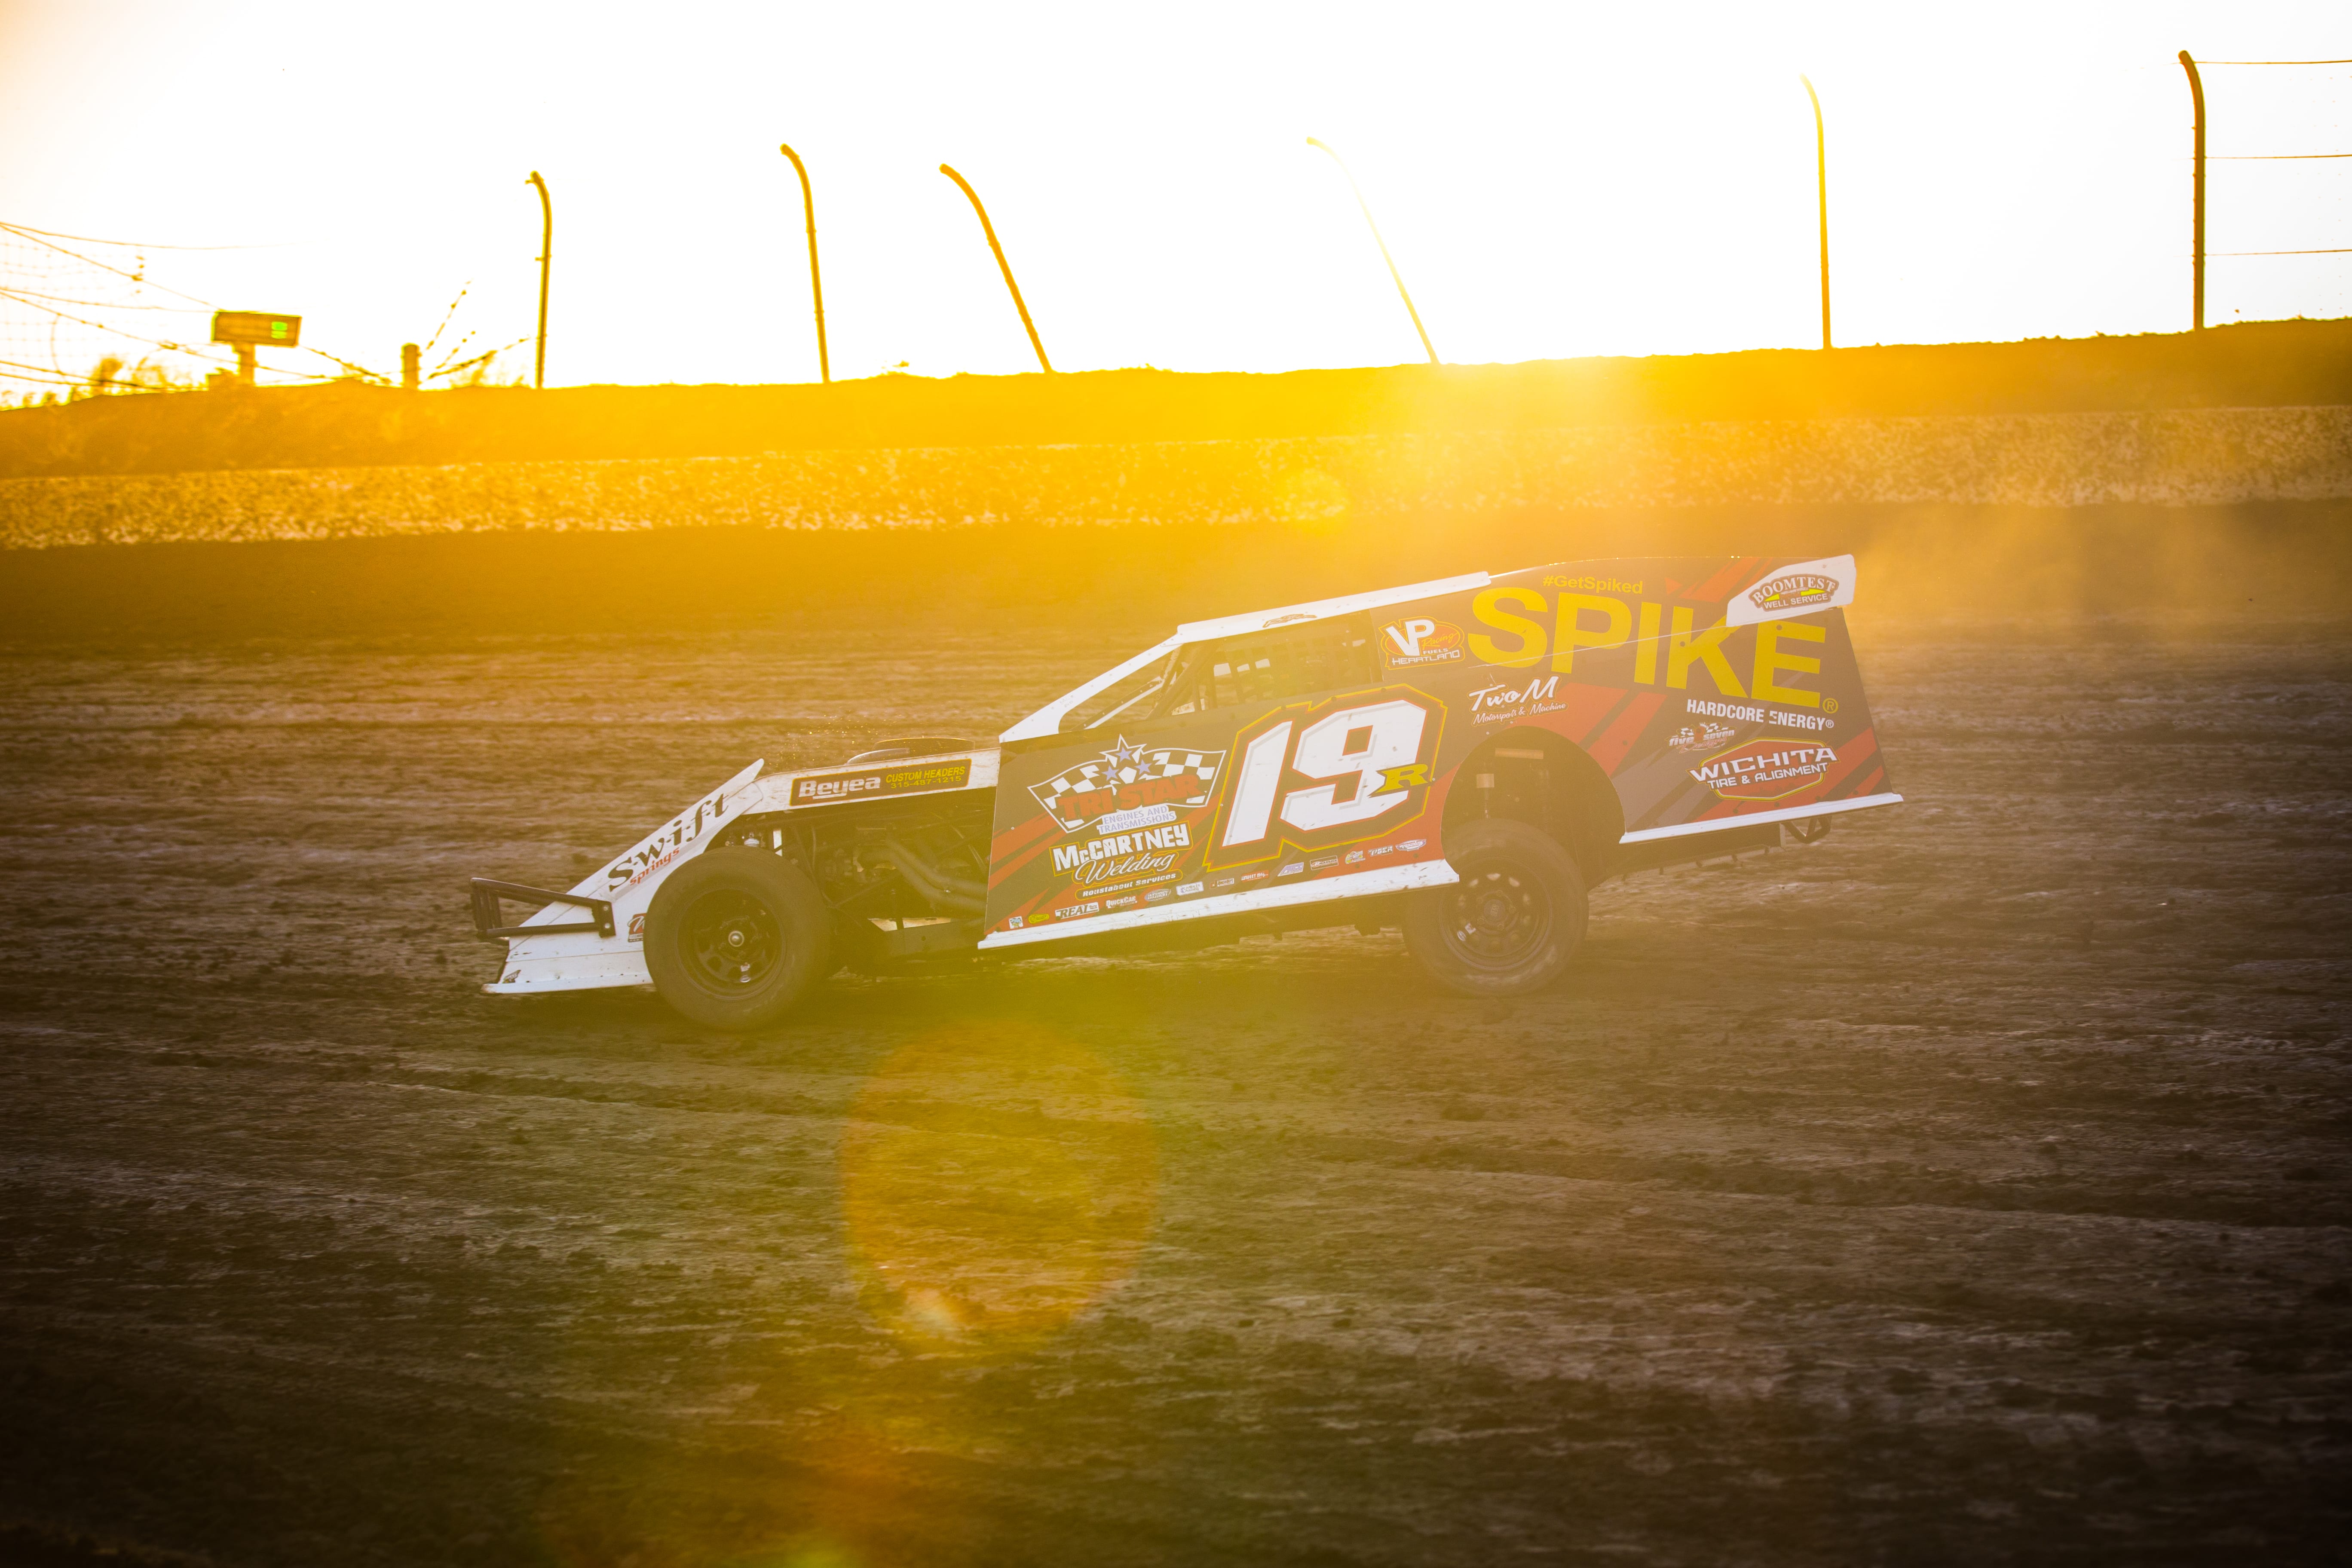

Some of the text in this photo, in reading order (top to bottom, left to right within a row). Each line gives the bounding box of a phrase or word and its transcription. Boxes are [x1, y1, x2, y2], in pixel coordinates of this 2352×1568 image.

[1543, 575, 1643, 594] #GetSpiked
[1752, 576, 1836, 604] BOOMTEST
[1764, 593, 1828, 609] WELL SERVICE
[1385, 619, 1435, 656] VP
[1421, 632, 1458, 650] Racing
[1392, 649, 1460, 665] HEARTLAND
[1468, 676, 1559, 710] Two M
[1519, 706, 1525, 715] &
[1529, 703, 1566, 715] Machine
[1686, 699, 1764, 723] HARDCORE
[1669, 729, 1735, 747] five seven
[885, 766, 966, 784] CUSTOM HEADERS
[1222, 700, 1427, 847] 19
[1689, 747, 1838, 782] WICHITA
[1707, 762, 1828, 789] TIRE & ALIGNMENT
[798, 777, 881, 799] Beyea
[891, 775, 962, 789] 315-487-1215
[1057, 774, 1204, 820] TRI STAR
[1098, 812, 1176, 833] TRANSMISSIONS
[1103, 805, 1168, 825] ENGINES AND
[608, 793, 729, 892] Swift
[630, 847, 680, 886] springs
[1075, 852, 1176, 884] Welding
[1082, 873, 1176, 897] Roustabout Services
[1057, 904, 1088, 919] REAL
